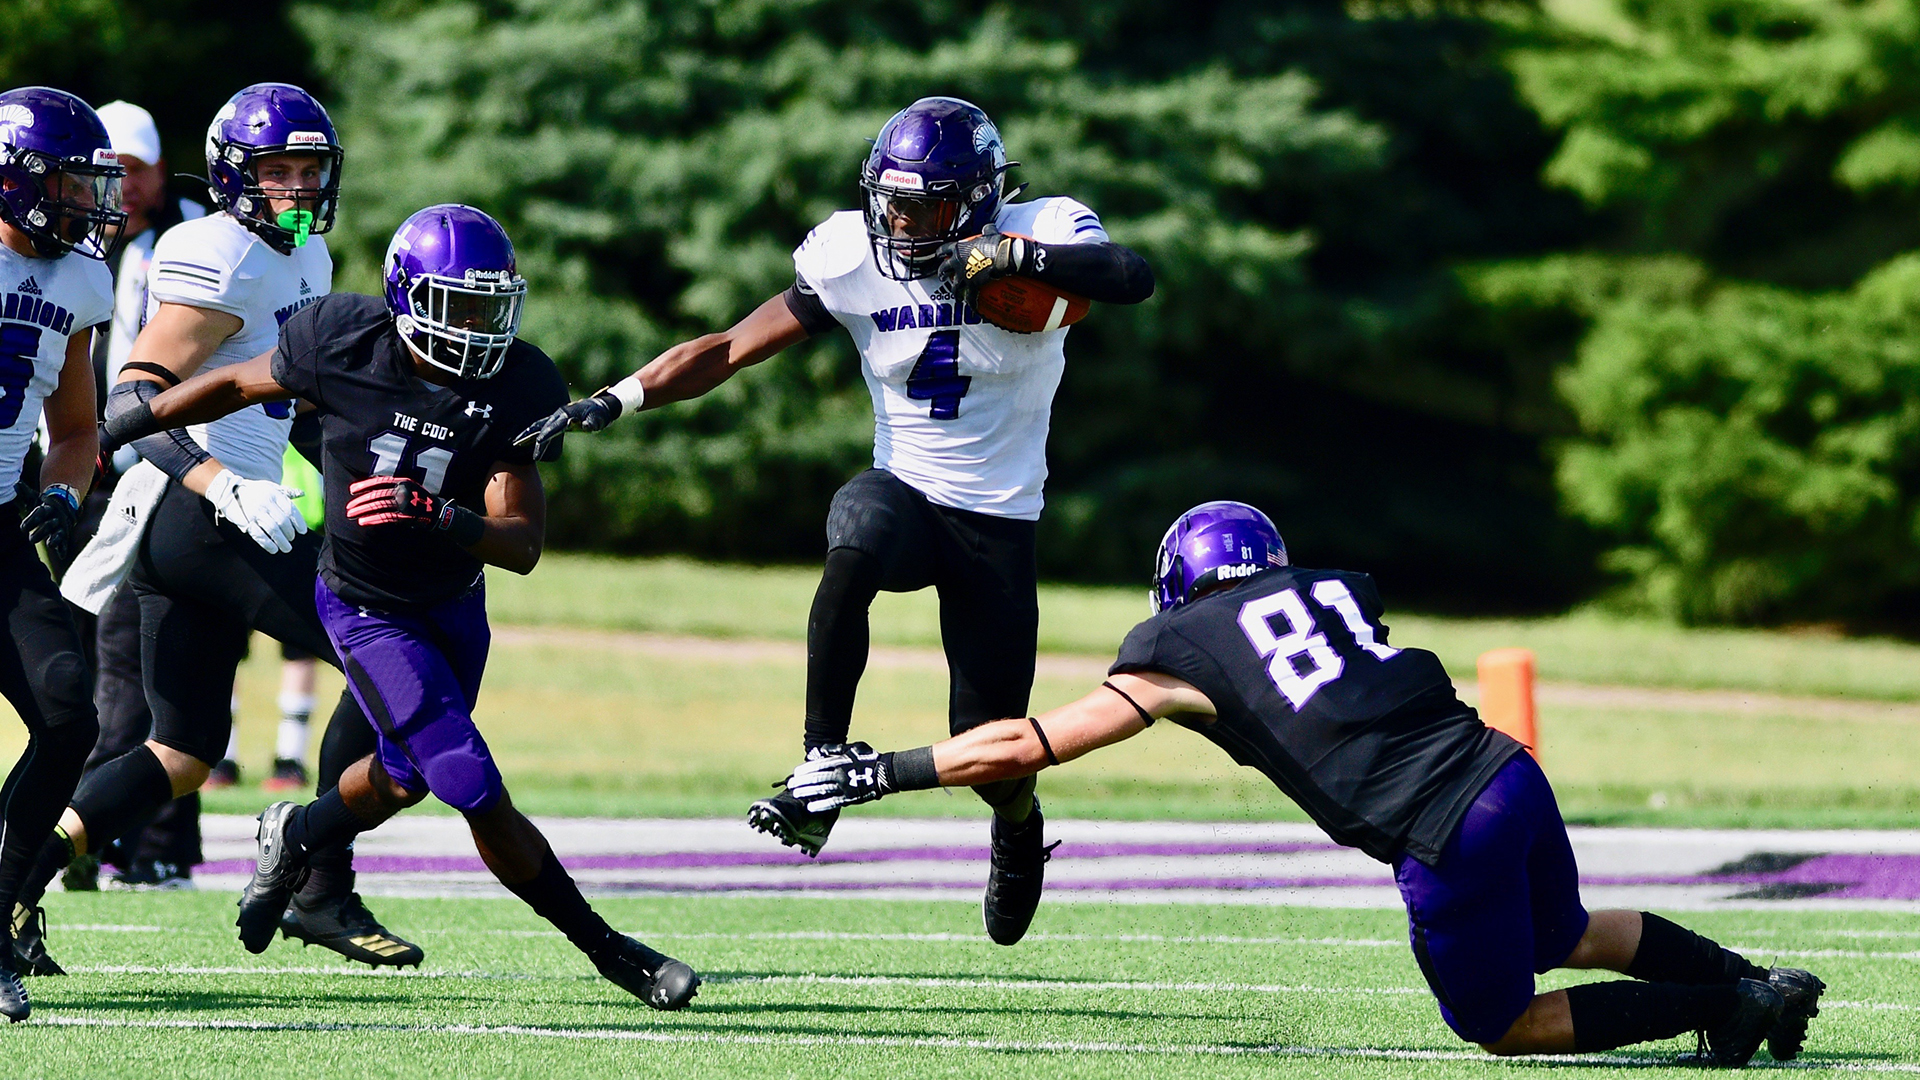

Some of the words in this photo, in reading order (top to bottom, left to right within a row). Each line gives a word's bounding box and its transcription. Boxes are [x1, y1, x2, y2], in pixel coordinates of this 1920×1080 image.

[294, 134, 324, 142] Riddell
[885, 173, 918, 185] Riddell
[475, 270, 500, 280] Riddell
[965, 257, 993, 279] adidas
[0, 291, 75, 336] RRIORS
[870, 301, 993, 333] WARRIO
[906, 329, 972, 420] 4
[393, 411, 418, 432] THE
[367, 430, 459, 495] 11
[1240, 545, 1253, 560] 81
[1217, 563, 1264, 581] Ridd
[1236, 578, 1402, 713] 81
